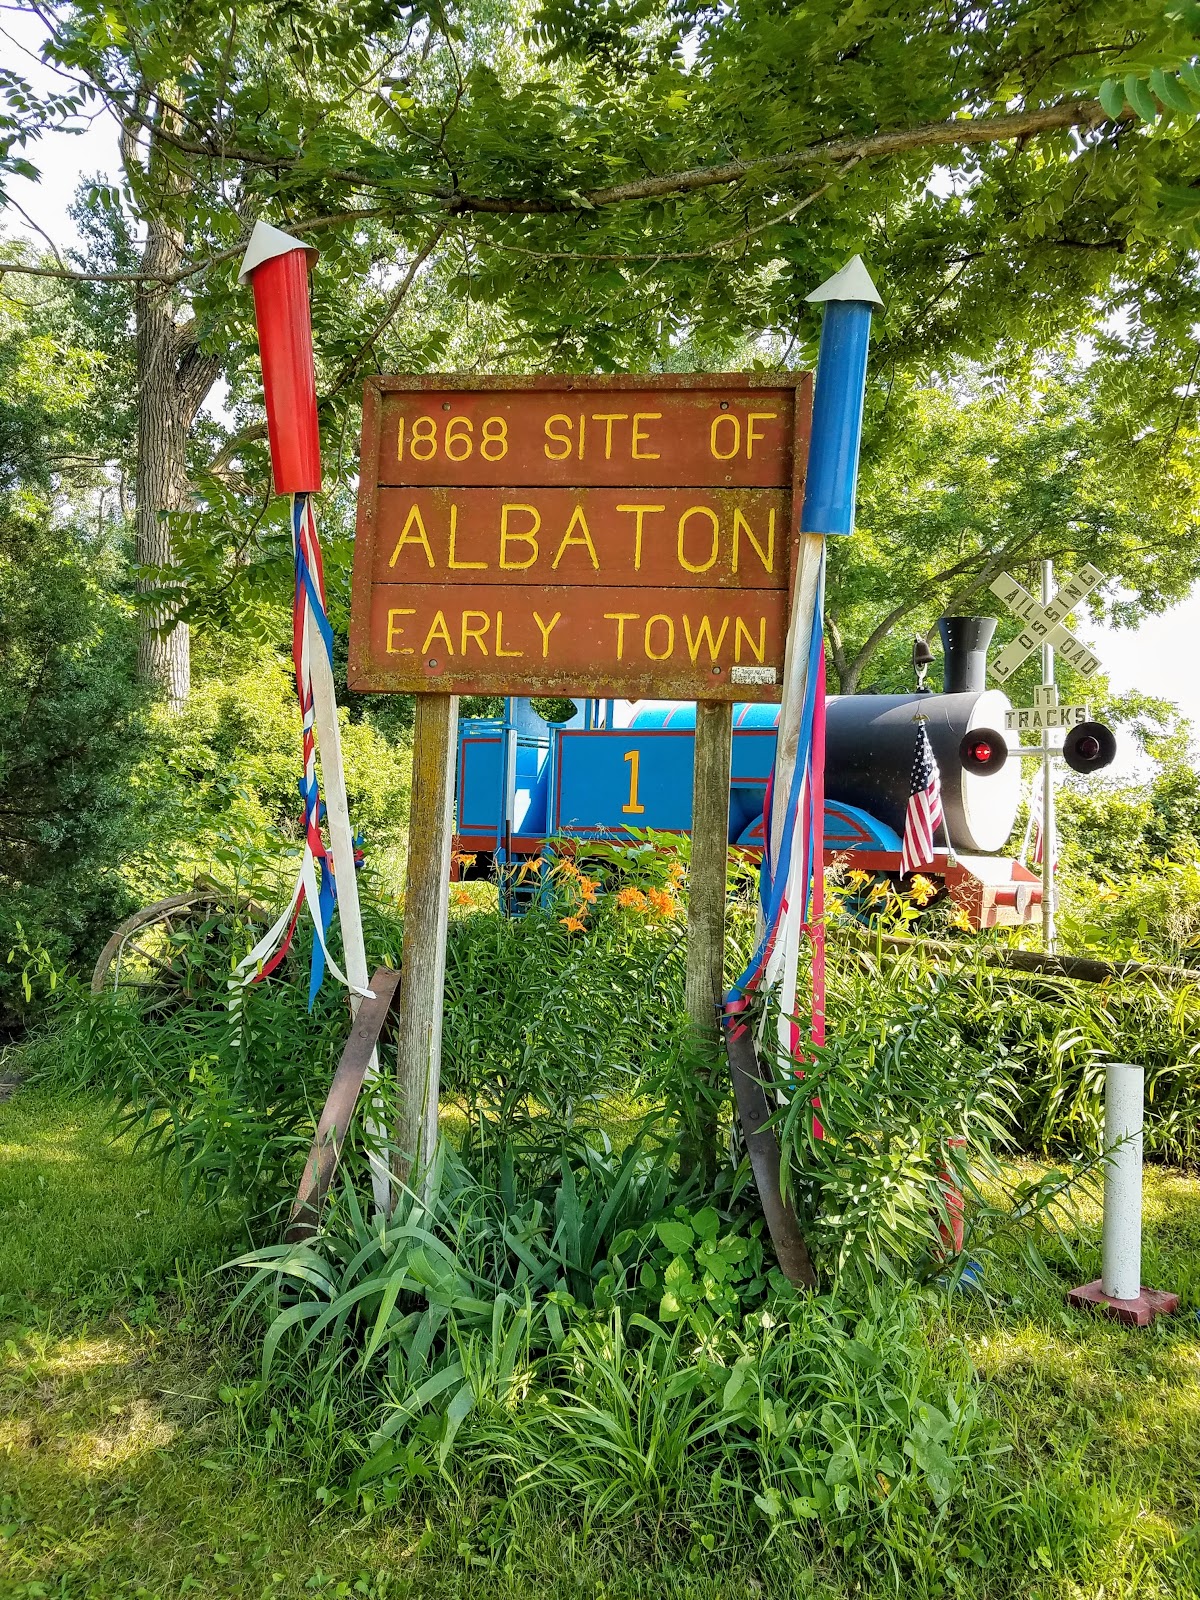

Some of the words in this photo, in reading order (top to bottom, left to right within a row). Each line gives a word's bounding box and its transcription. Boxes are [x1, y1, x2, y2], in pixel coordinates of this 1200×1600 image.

[397, 415, 508, 462] 1868
[544, 413, 663, 461] SITE
[710, 413, 778, 460] OF
[389, 503, 776, 573] ALBATON
[386, 608, 562, 657] EARLY
[603, 612, 767, 663] TOWN
[1005, 707, 1086, 729] TRACKS
[622, 750, 645, 814] 1
